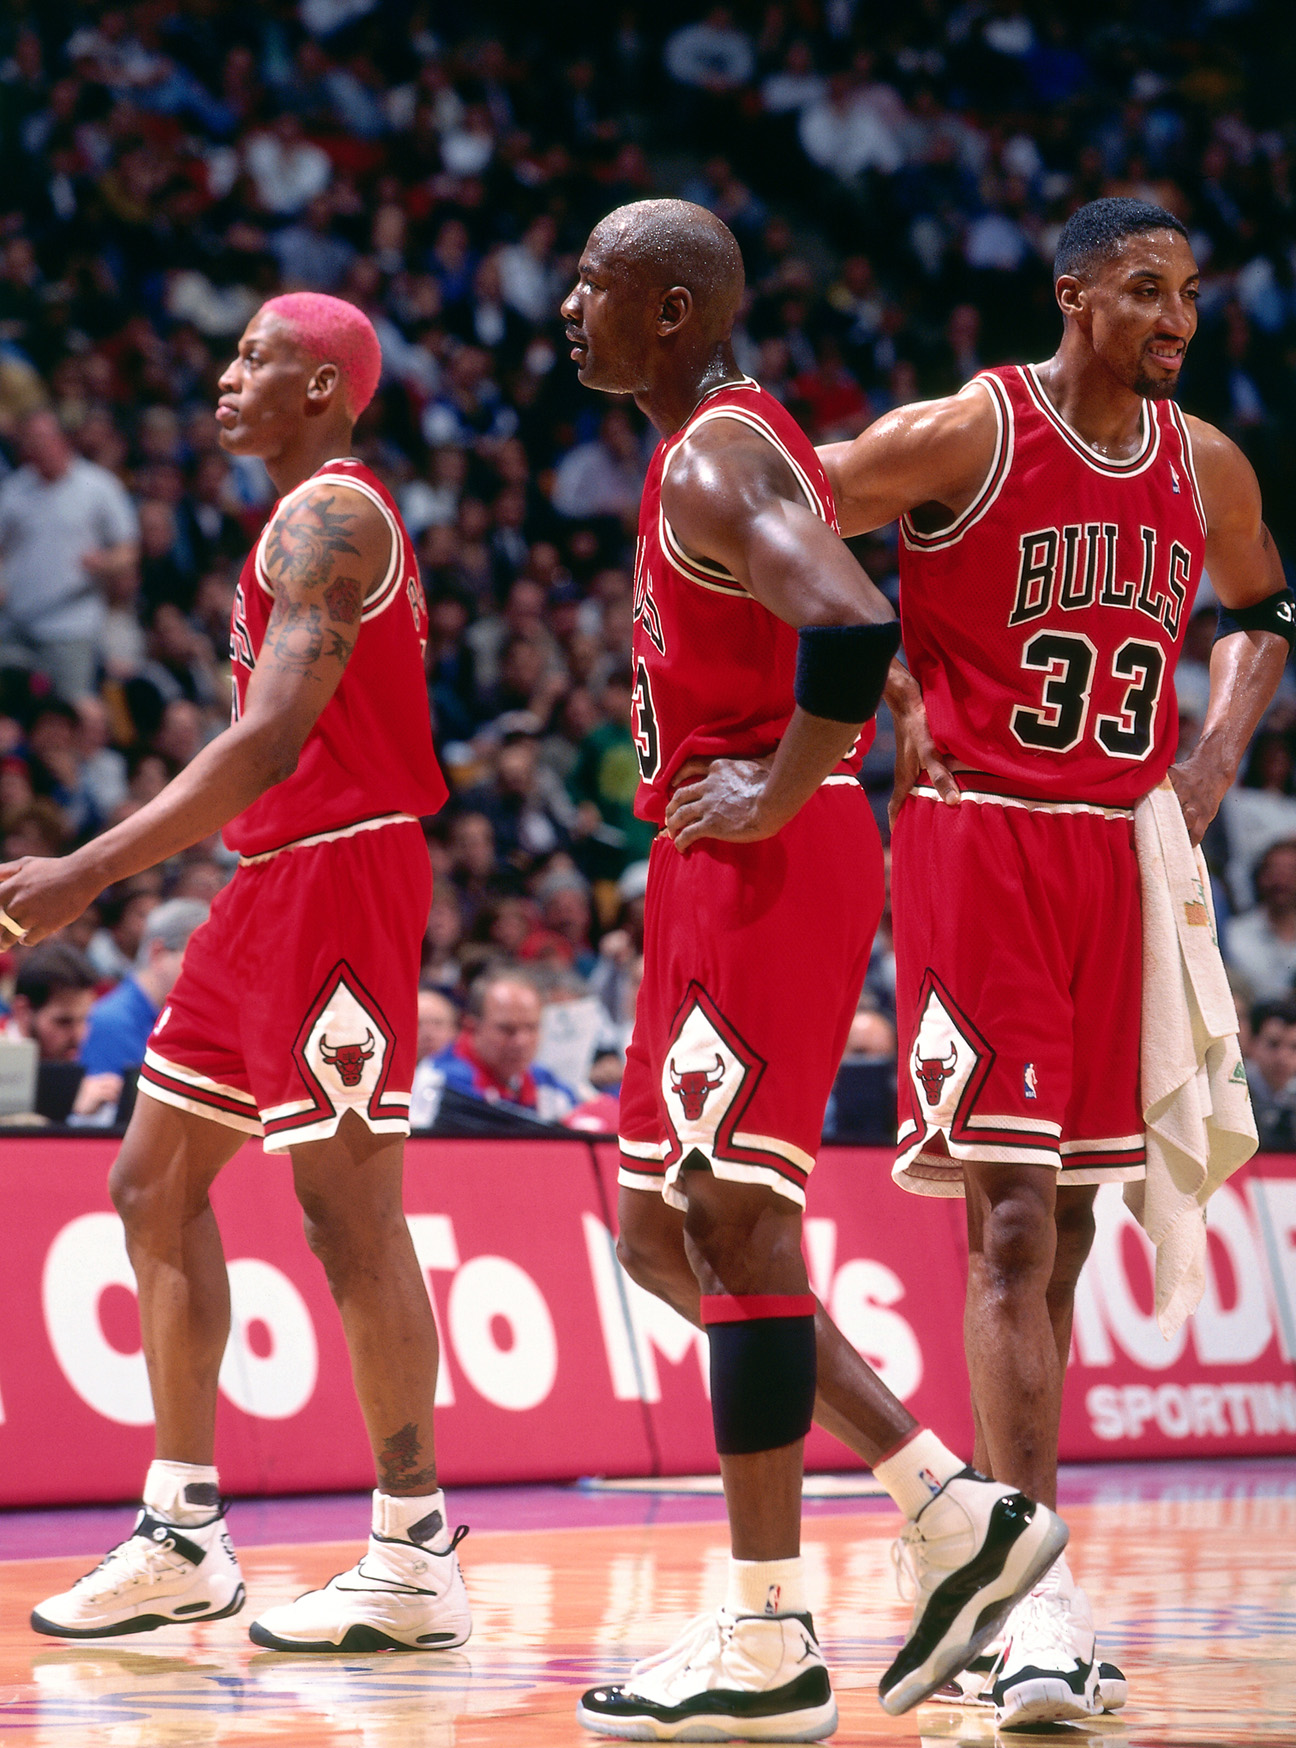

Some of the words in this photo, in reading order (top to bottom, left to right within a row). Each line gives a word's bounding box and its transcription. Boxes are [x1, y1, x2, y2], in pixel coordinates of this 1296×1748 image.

[1007, 521, 1192, 643] BULLS
[631, 648, 662, 786] 3
[1009, 628, 1167, 762] 33
